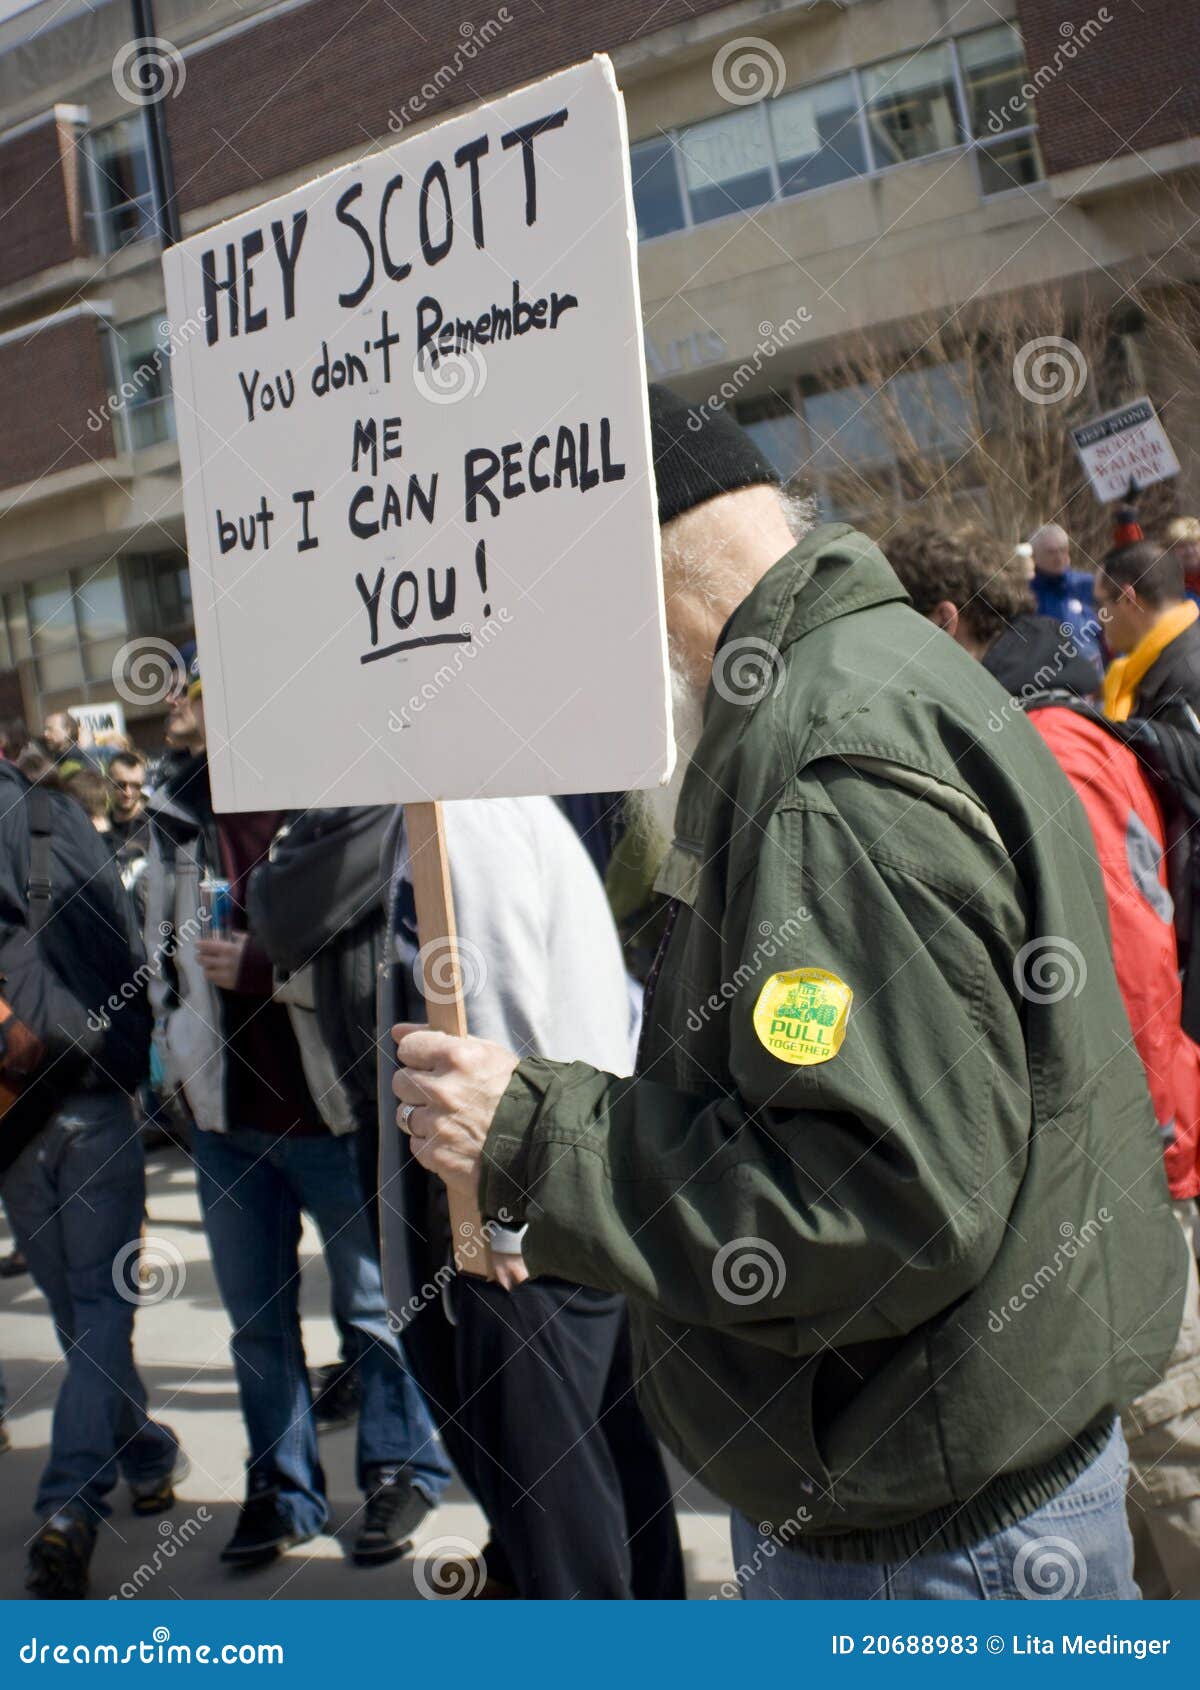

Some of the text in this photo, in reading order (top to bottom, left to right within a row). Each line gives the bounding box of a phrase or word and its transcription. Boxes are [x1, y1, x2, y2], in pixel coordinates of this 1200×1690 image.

[201, 108, 569, 346] HEY SCOTT
[311, 311, 400, 397] don't
[416, 280, 578, 372] Remember
[216, 417, 626, 554] but I CAN RECALL
[351, 416, 403, 476] ME
[768, 1037, 831, 1058] TOGETHER
[769, 1018, 831, 1047] PULL
